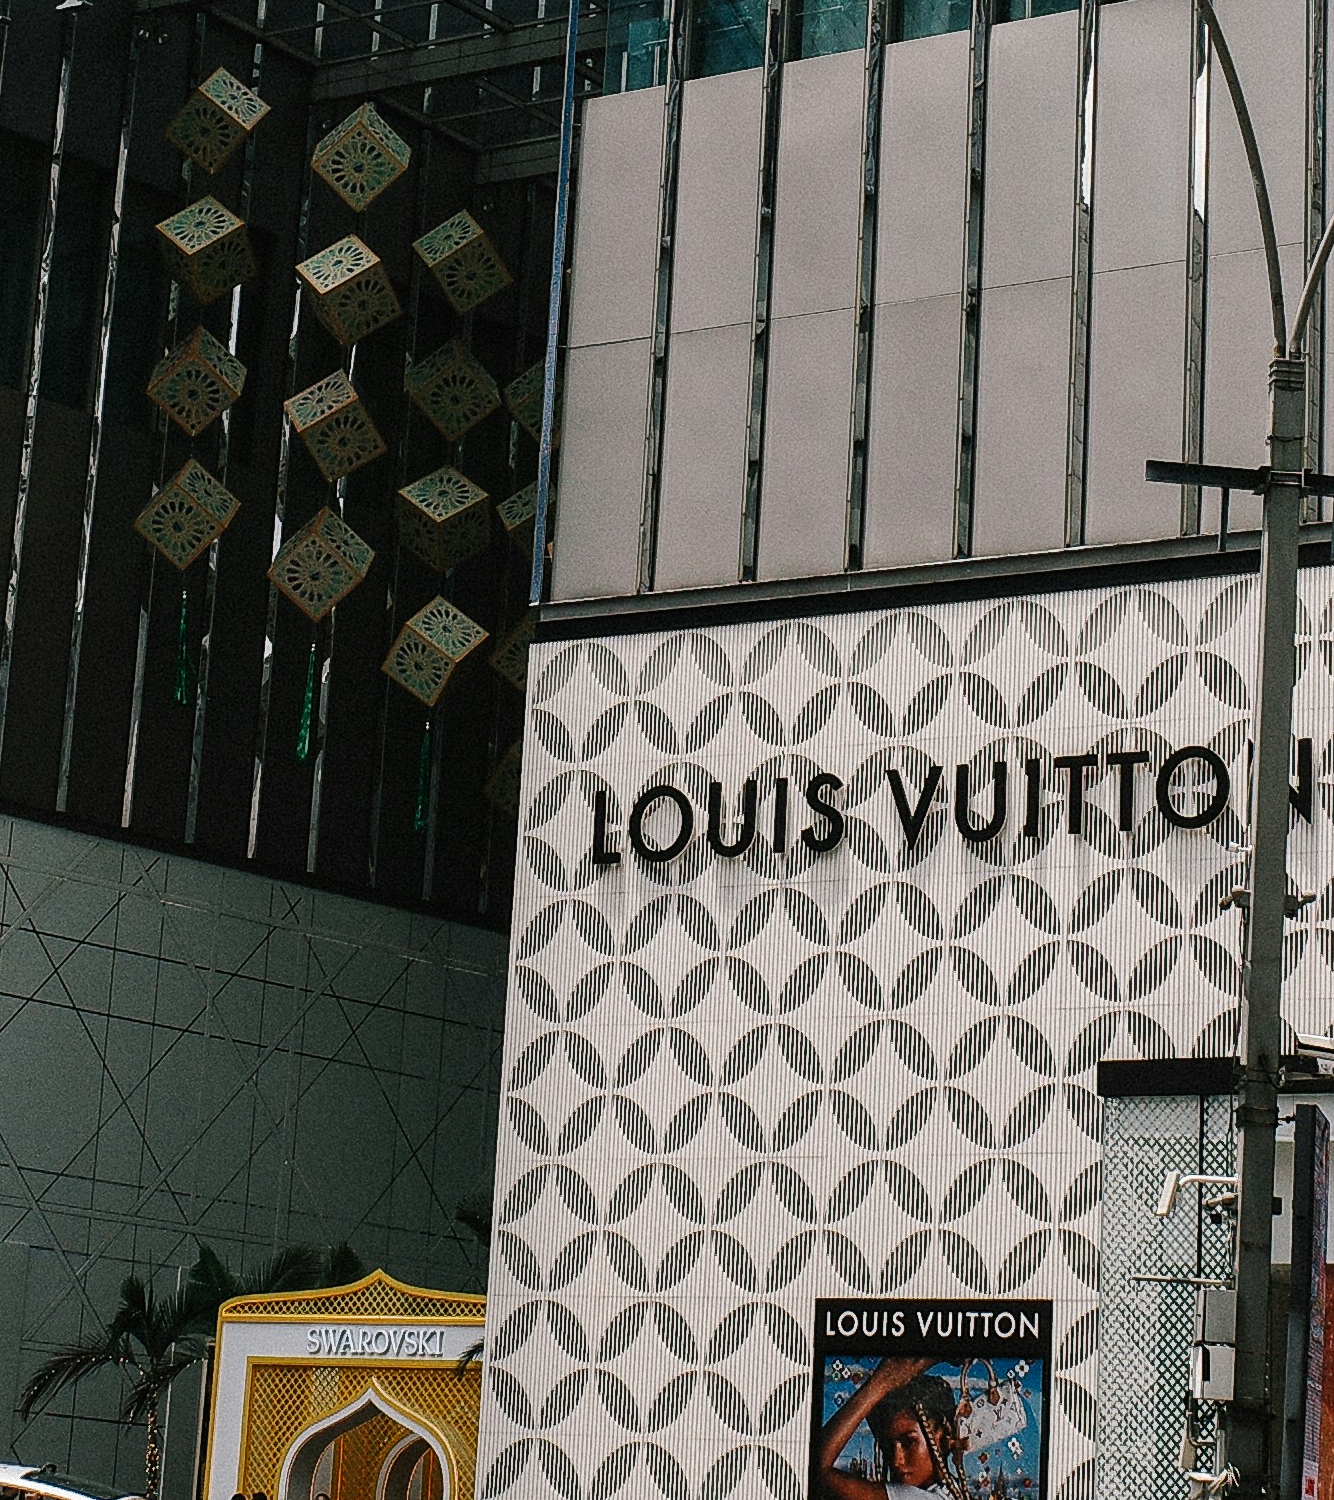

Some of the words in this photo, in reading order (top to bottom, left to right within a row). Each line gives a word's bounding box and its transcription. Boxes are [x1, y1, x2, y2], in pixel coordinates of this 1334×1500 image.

[593, 772, 847, 866] LOUIS
[825, 1310, 906, 1338] LOUIS
[916, 1311, 1040, 1340] VUITTON
[306, 1328, 445, 1357] SWAROVSKI
